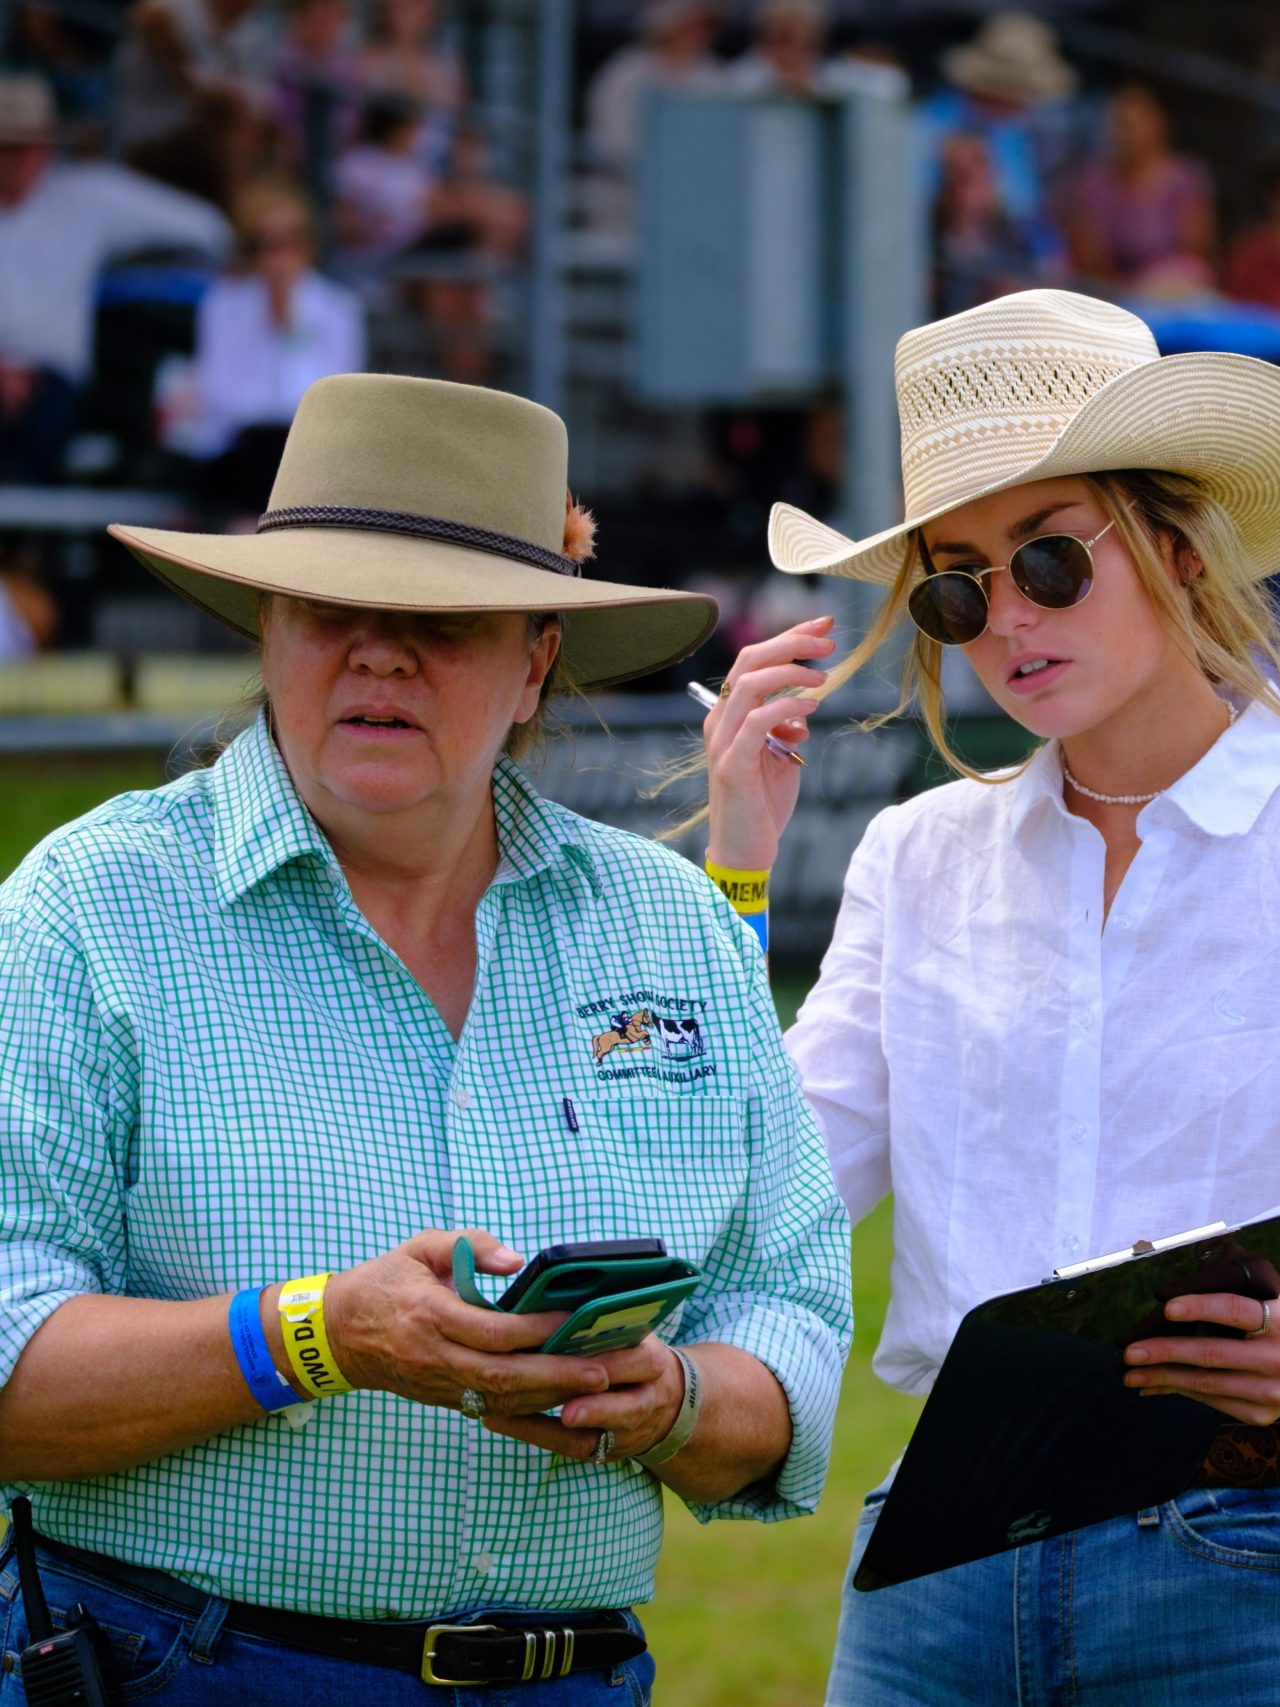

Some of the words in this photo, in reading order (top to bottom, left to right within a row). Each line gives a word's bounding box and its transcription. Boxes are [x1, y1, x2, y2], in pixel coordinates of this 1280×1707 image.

[576, 997, 615, 1018] BERRY
[619, 991, 654, 1006] SHOW
[655, 994, 707, 1013] SOCIETY
[598, 1066, 658, 1082] COMMITTEE
[663, 1064, 717, 1083] AUXILIARY
[299, 1347, 335, 1388] TWO
